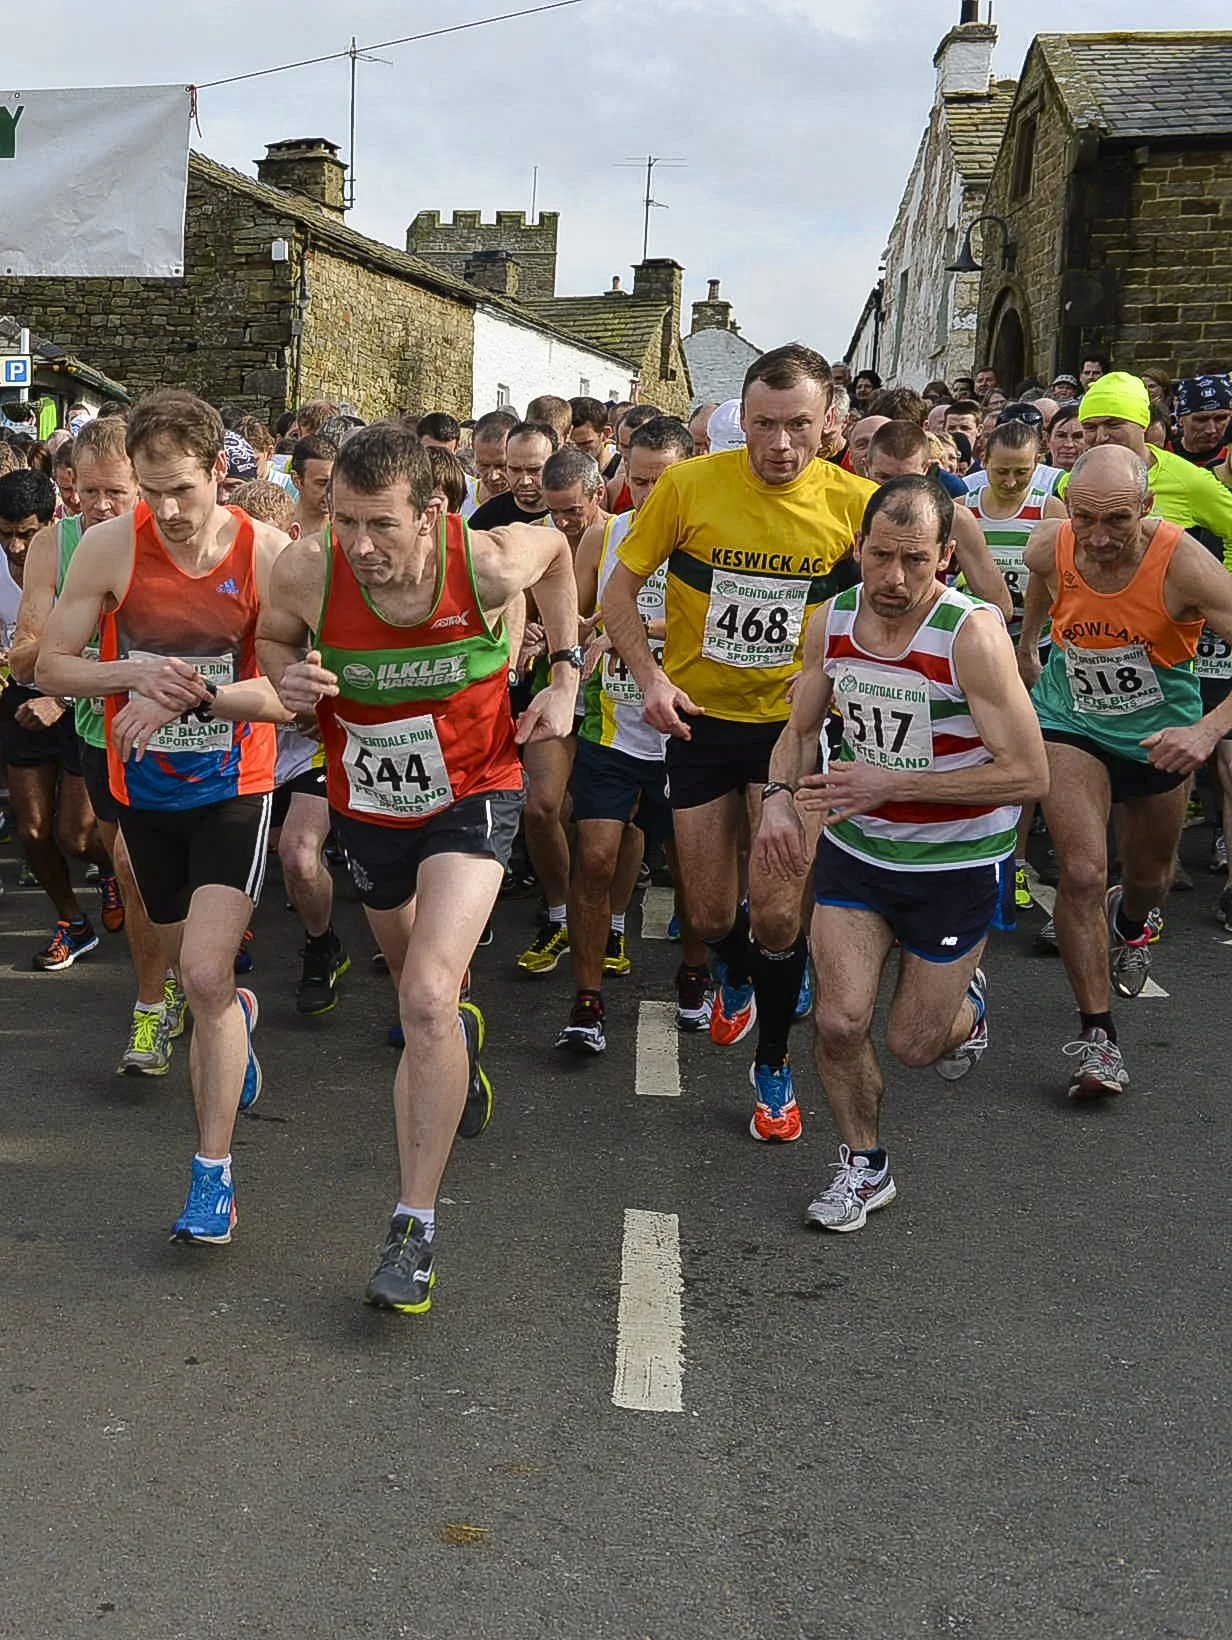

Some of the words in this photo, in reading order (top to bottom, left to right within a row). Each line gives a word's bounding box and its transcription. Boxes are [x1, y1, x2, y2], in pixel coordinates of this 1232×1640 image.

[10, 362, 24, 381] P
[711, 548, 793, 571] KESWICK
[798, 557, 824, 574] AC
[738, 586, 785, 600] DENTDALE
[786, 589, 806, 600] RUN
[716, 603, 789, 644] 468
[707, 636, 742, 653] PETE
[746, 644, 795, 654] BLAND
[377, 653, 469, 680] ILKLEY
[726, 652, 770, 663] SPORTS
[1201, 659, 1232, 668] BLAN
[209, 664, 230, 675] RUN
[377, 668, 467, 690] HARRIERS
[605, 682, 635, 692] PETE
[1073, 666, 1143, 695] 518
[858, 682, 903, 700] DENTDALE
[904, 690, 926, 703] RUN
[1110, 686, 1158, 705] BLAND
[178, 723, 229, 738] BLAND
[409, 729, 434, 744] RUN
[848, 702, 914, 754] 517
[158, 737, 205, 747] SPORTS
[353, 746, 432, 792] 544
[879, 752, 930, 769] BLAND
[392, 787, 448, 805] BLAND
